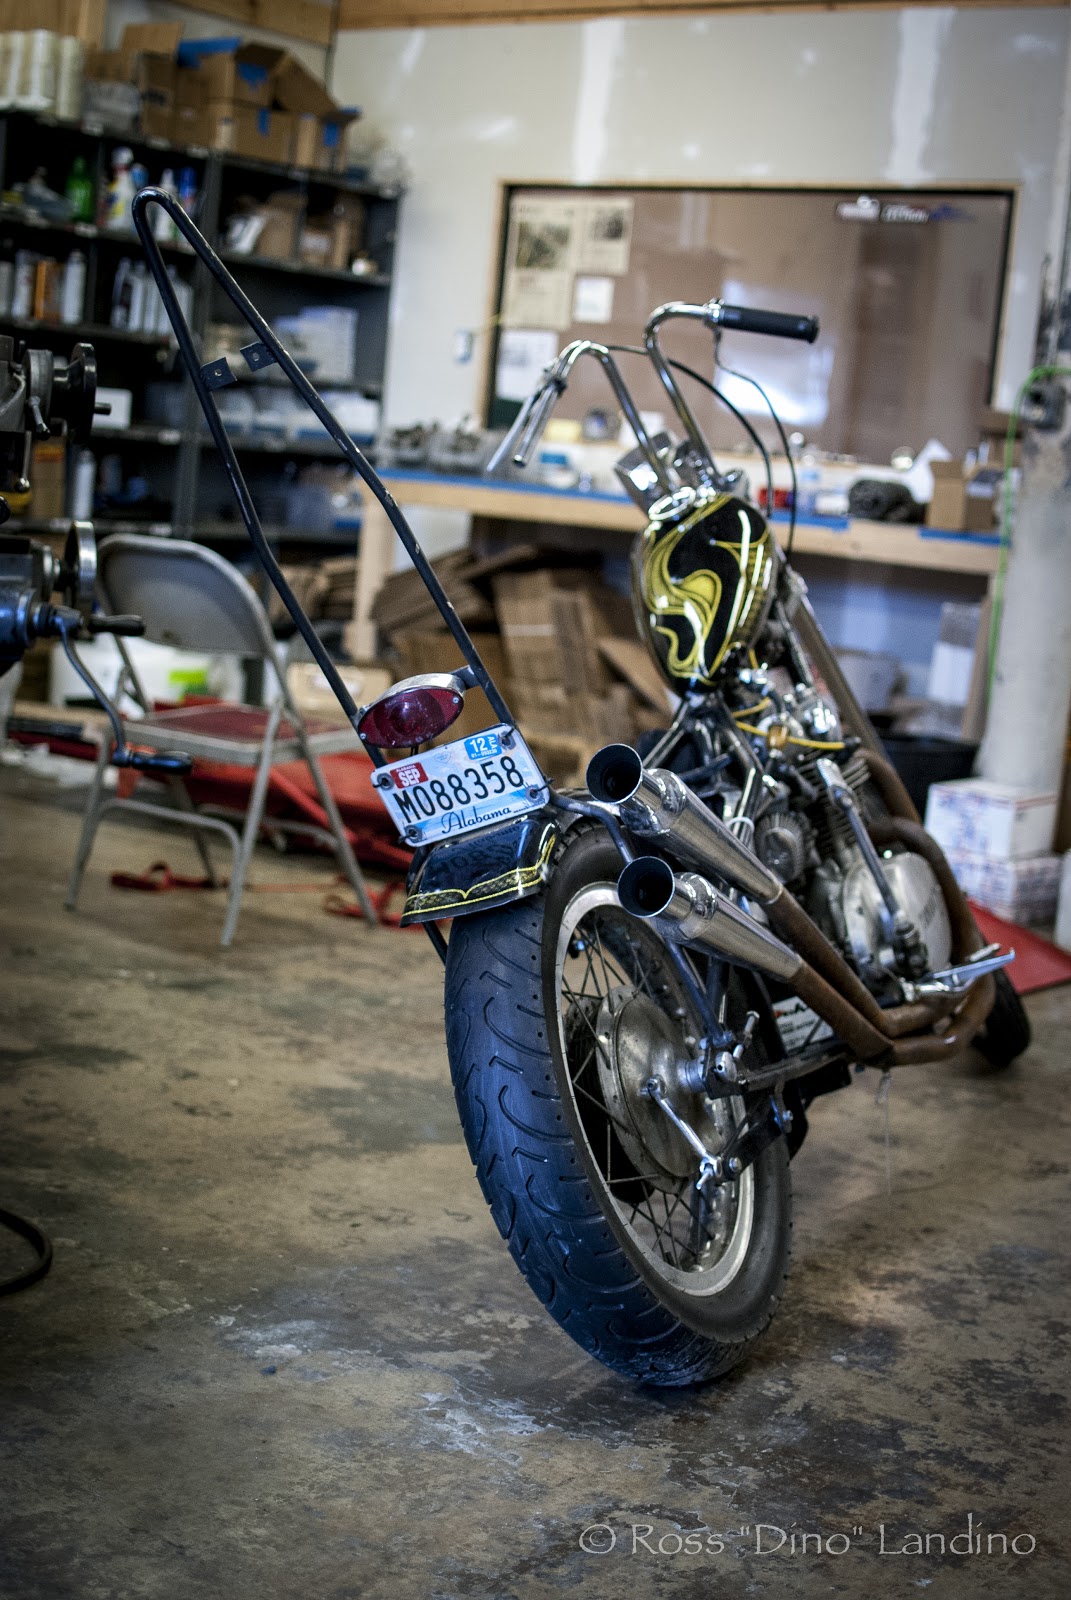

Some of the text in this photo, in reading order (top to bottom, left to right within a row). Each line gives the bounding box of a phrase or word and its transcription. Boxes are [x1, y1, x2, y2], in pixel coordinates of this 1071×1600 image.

[469, 737, 488, 753] 12
[392, 755, 526, 824] M088358
[398, 768, 421, 787] SEP
[441, 805, 512, 834] Alabama
